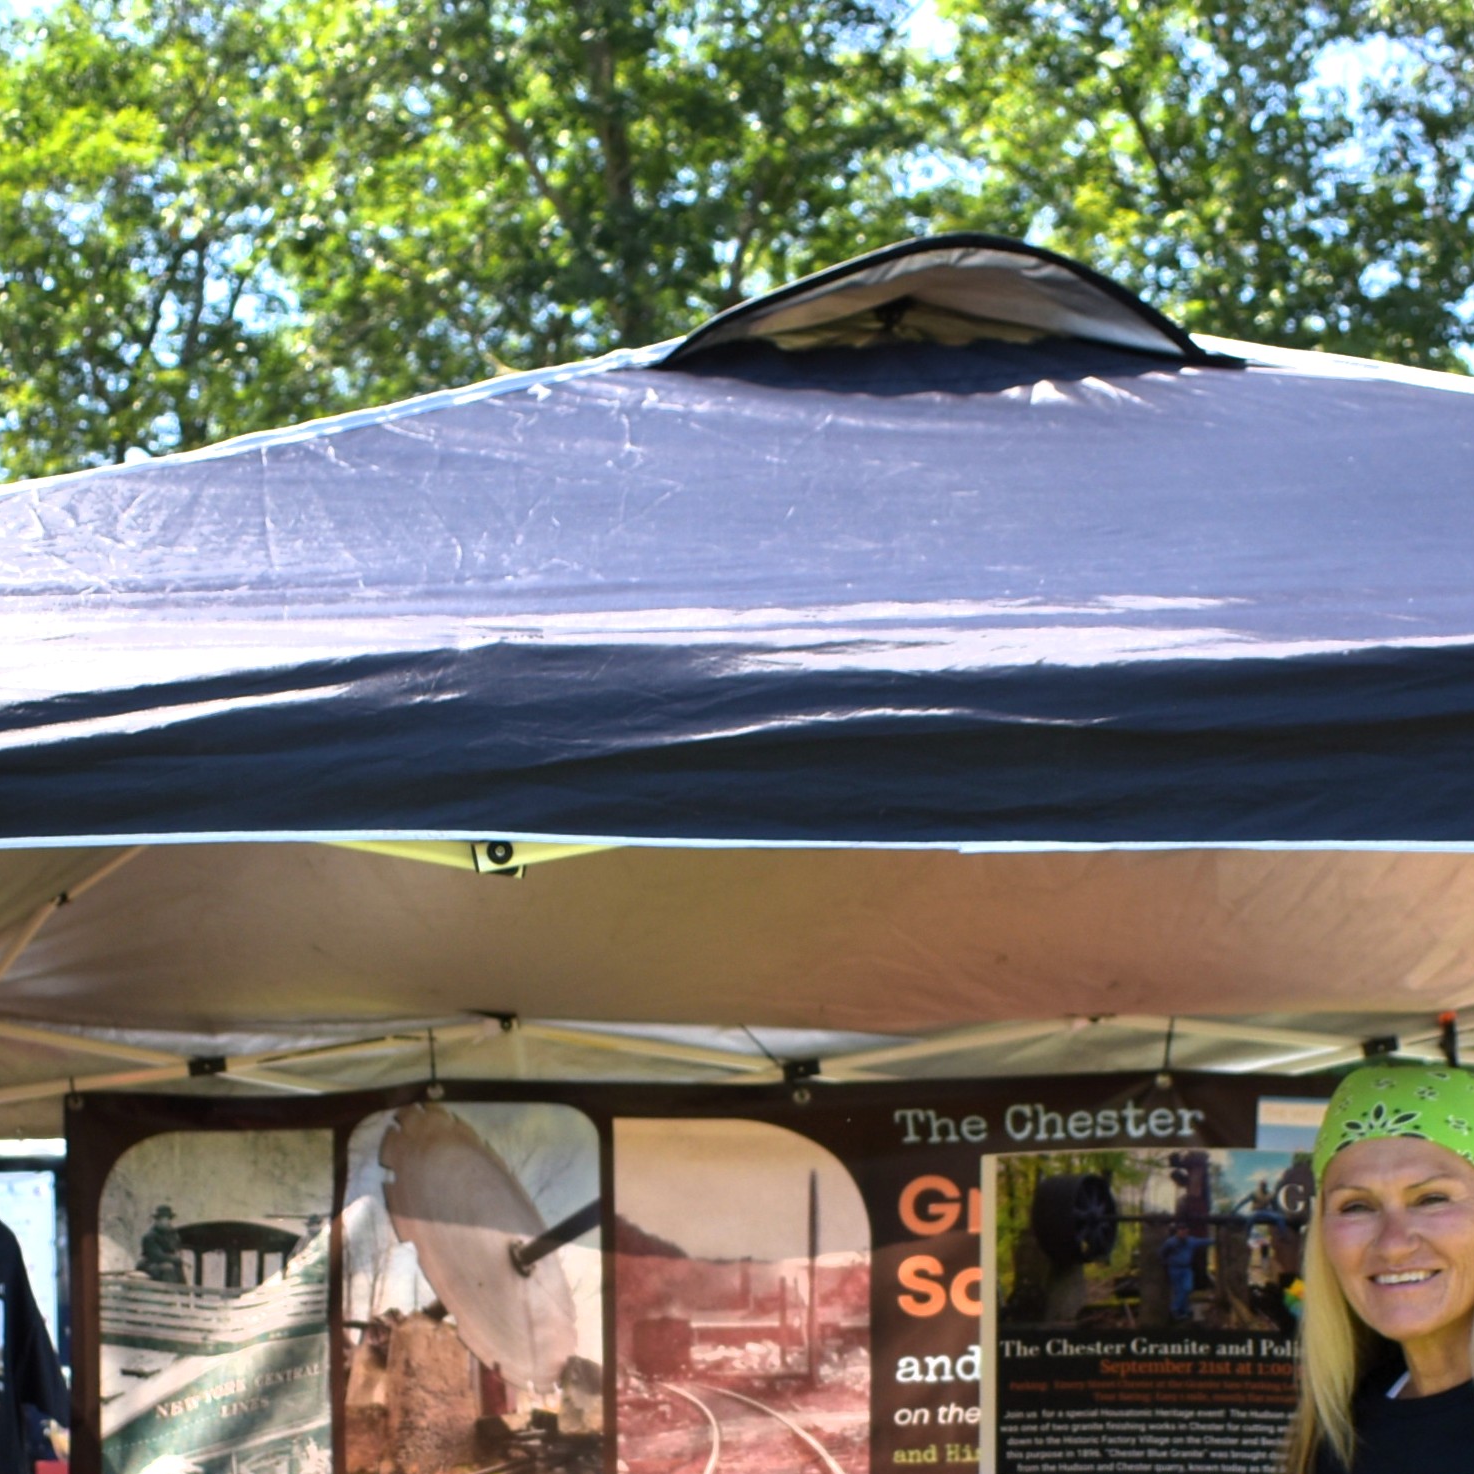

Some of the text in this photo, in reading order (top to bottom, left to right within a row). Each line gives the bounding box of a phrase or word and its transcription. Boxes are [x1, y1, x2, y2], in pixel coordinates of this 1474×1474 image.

[895, 1100, 1204, 1143] The Chester
[999, 1338, 1252, 1358] The Chester Granite and
[895, 1345, 981, 1383] and
[1100, 1360, 1192, 1376] September
[1236, 1361, 1252, 1374] at
[894, 1404, 981, 1426] on the
[893, 1446, 937, 1464] and
